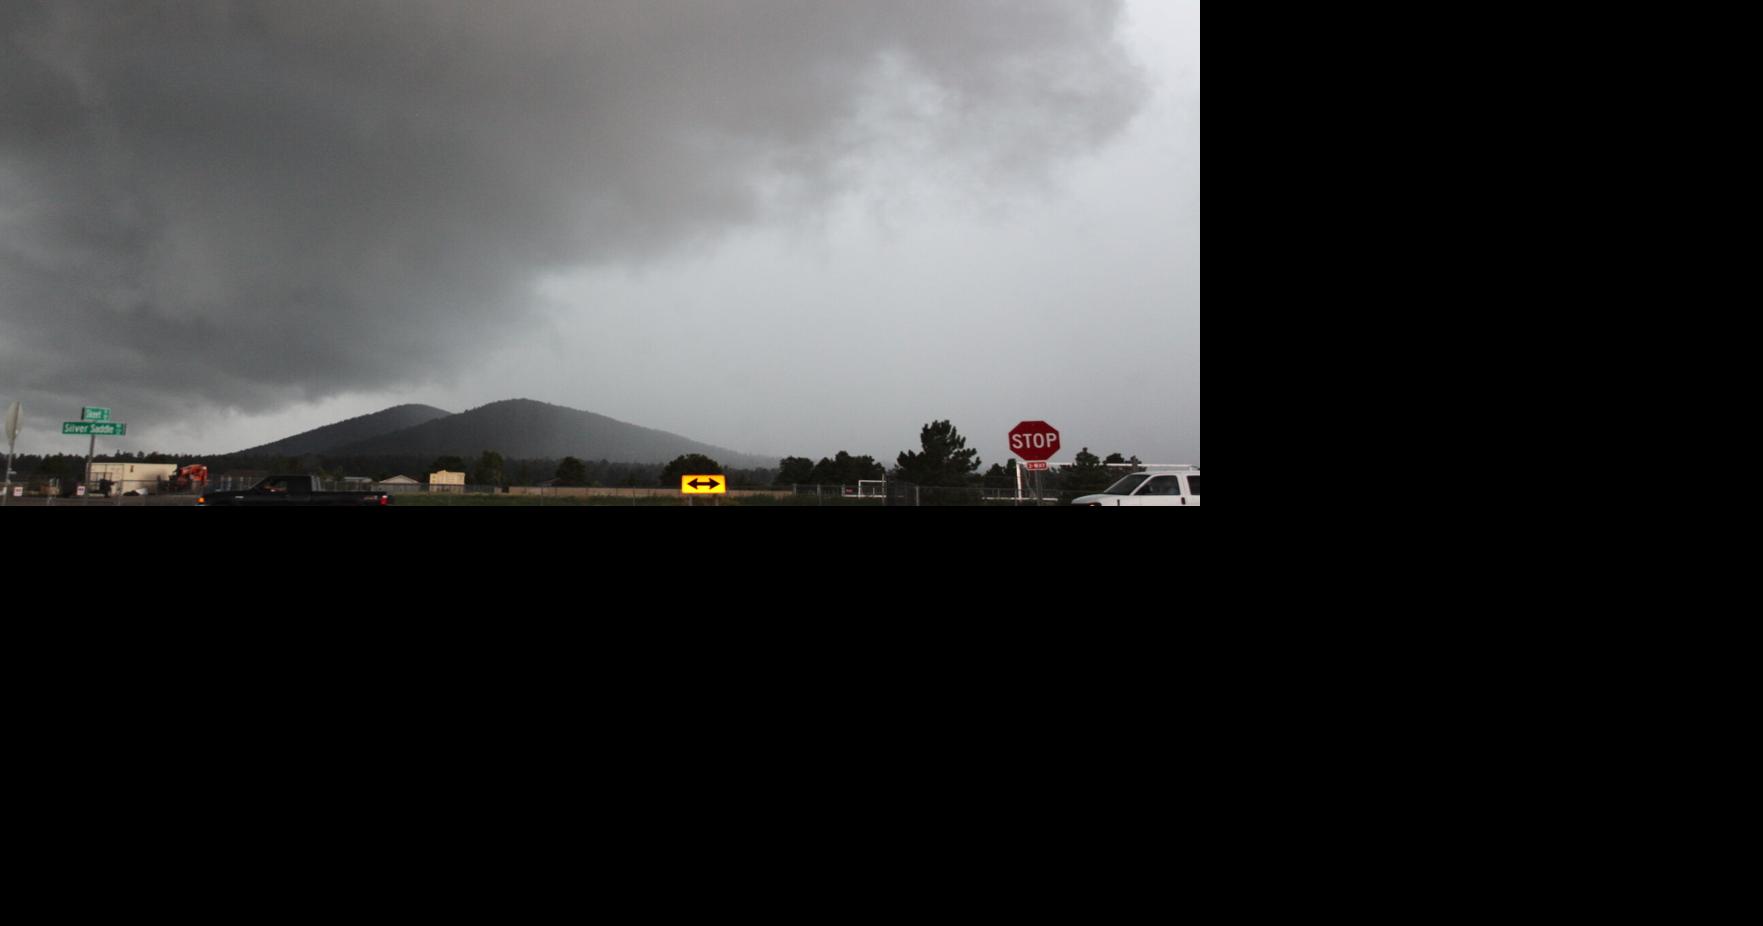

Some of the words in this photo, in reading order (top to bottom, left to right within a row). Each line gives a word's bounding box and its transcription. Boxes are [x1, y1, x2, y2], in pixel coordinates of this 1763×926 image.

[64, 423, 88, 433] Silver
[89, 423, 114, 433] Saddle
[1012, 432, 1057, 449] STOP
